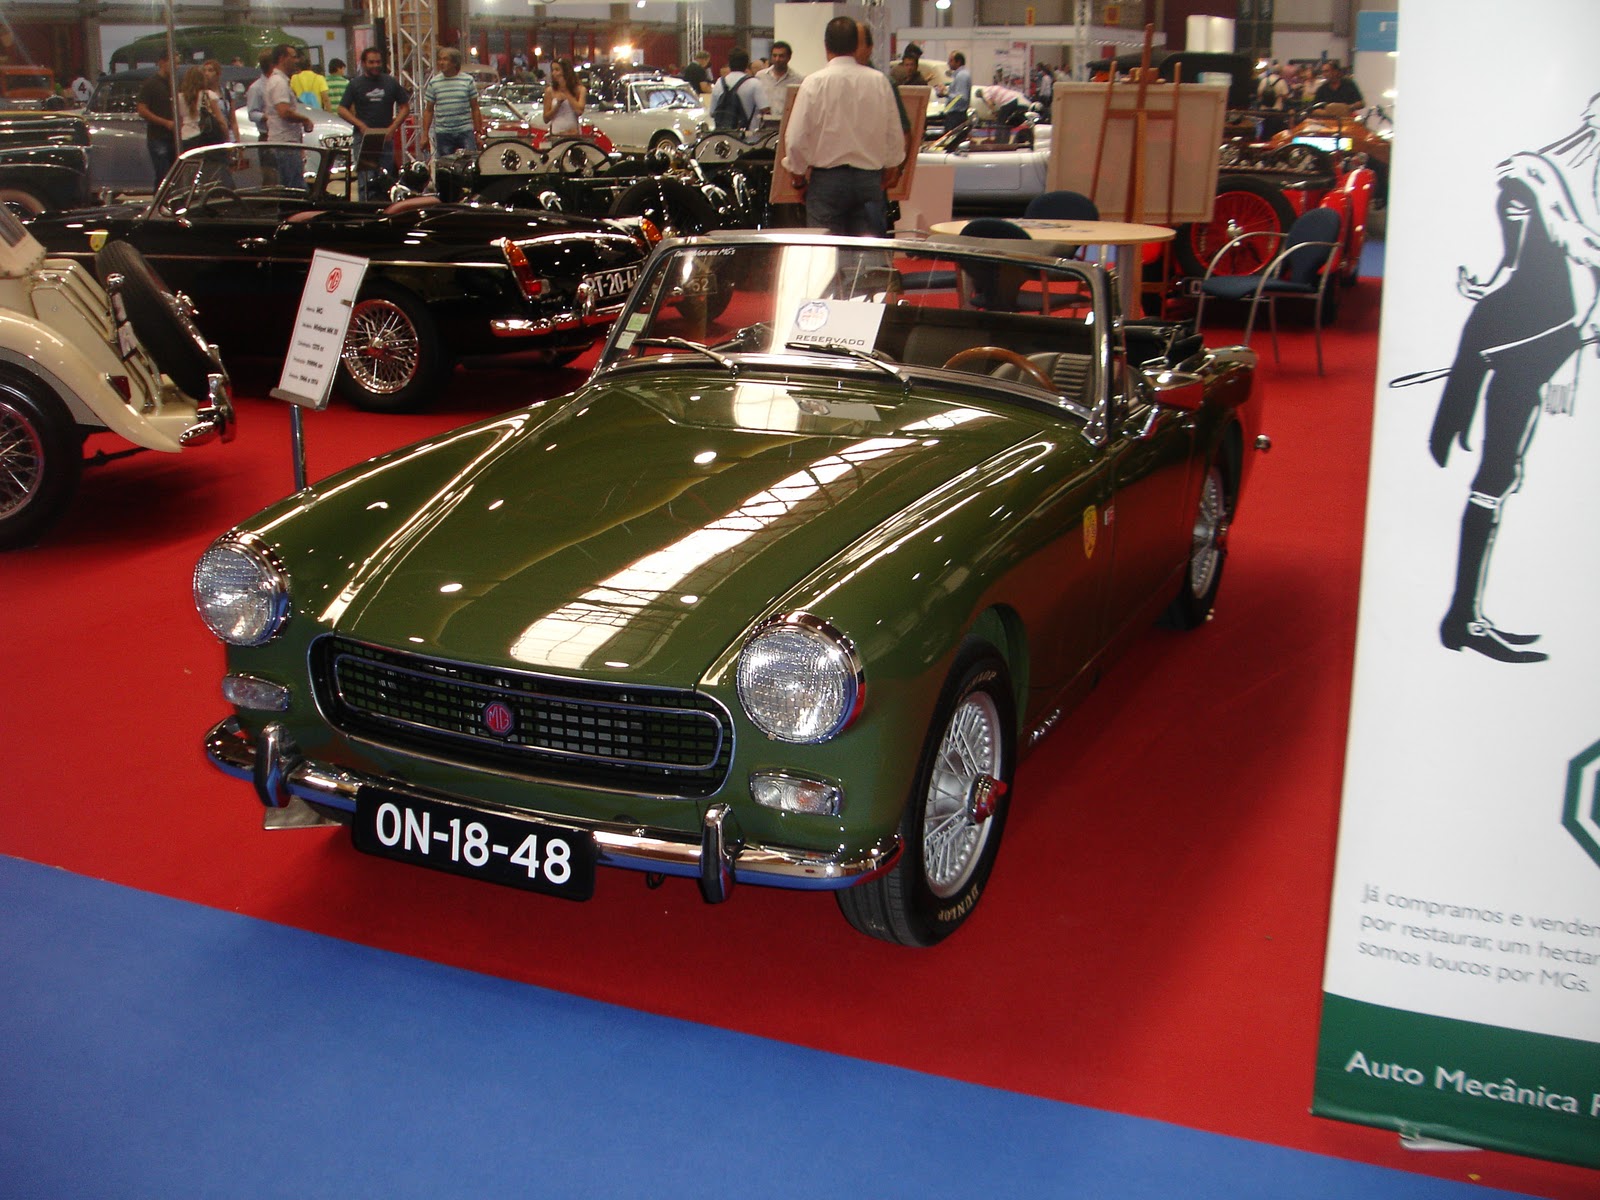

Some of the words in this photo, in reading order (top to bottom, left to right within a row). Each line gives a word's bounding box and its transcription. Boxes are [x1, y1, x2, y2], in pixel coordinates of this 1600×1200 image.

[78, 81, 87, 94] 4
[795, 334, 866, 346] RESERVADO
[488, 705, 510, 730] MG
[376, 802, 571, 884] ON-18-48
[937, 883, 979, 921] DUNLOP
[1361, 884, 1379, 903] Já
[1385, 893, 1504, 924] compramos
[1509, 913, 1524, 926] e
[1360, 914, 1396, 931] por
[1498, 939, 1531, 955] um
[1358, 940, 1421, 965] somos
[1427, 952, 1491, 977] loucos
[1497, 966, 1533, 983] por
[1539, 969, 1591, 992] MGs.
[1344, 1051, 1425, 1086] Auto
[1435, 1066, 1579, 1113] Mecânica
